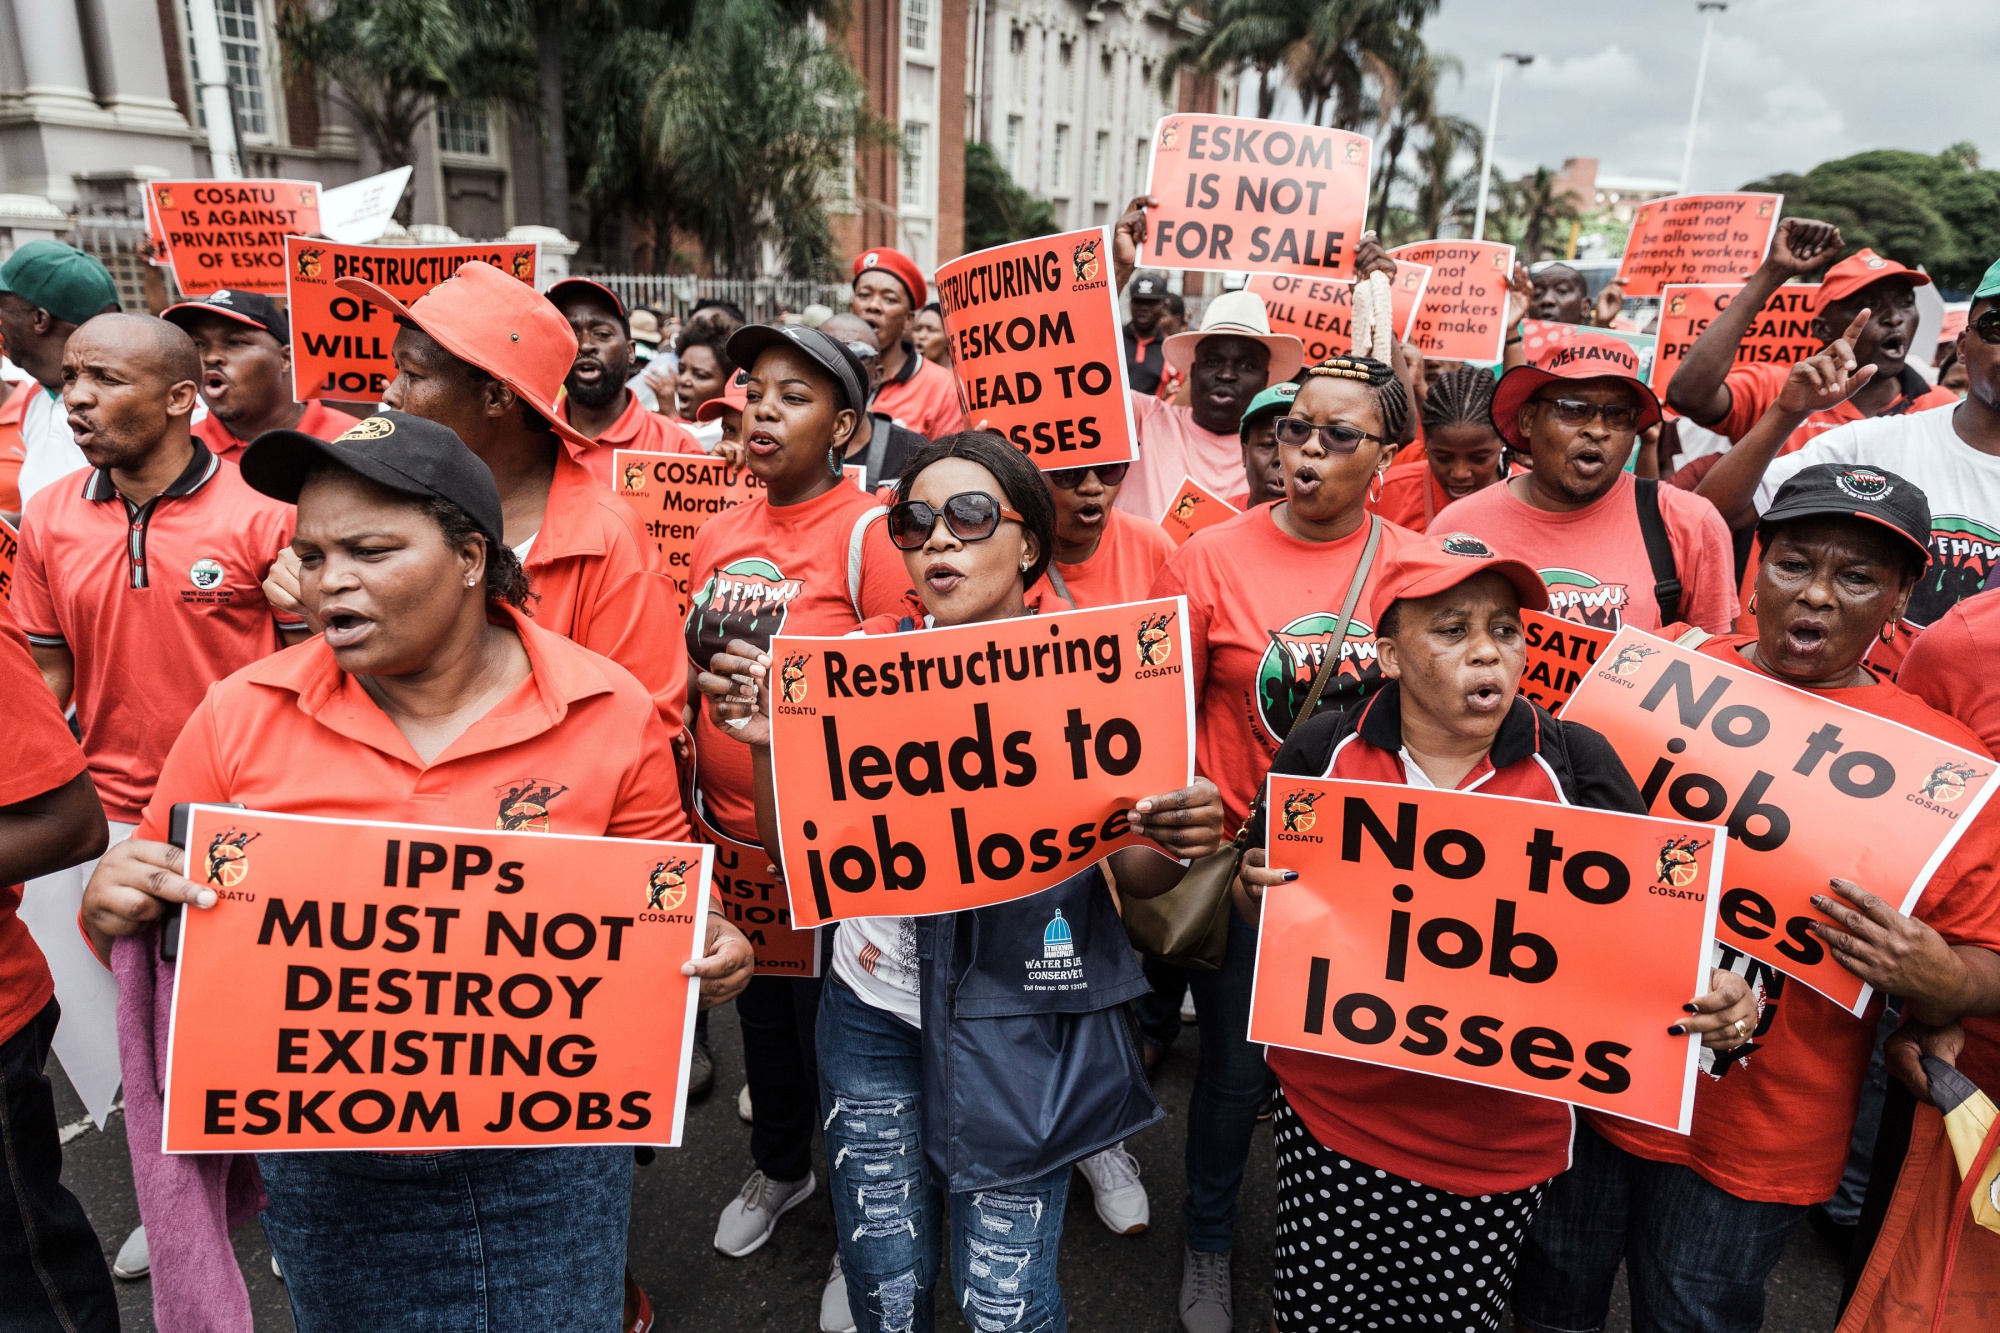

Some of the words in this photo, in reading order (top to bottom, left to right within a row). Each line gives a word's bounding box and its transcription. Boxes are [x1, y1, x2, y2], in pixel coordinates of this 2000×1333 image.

[1188, 125, 1332, 170] ESKOM
[194, 188, 275, 204] COSATU
[1185, 173, 1220, 210] IS
[1235, 175, 1327, 216] NOT
[181, 210, 200, 226] IS
[208, 210, 297, 226] AGAINST
[1659, 203, 1668, 213] A
[1673, 200, 1746, 214] company
[1663, 216, 1700, 227] must
[1705, 215, 1732, 226] not
[170, 231, 304, 247] PRIVATISATI
[1155, 220, 1233, 261] FOR
[1248, 226, 1345, 269] SALE
[1642, 233, 1658, 244] be
[1663, 229, 1727, 243] allowed
[1733, 231, 1749, 242] to
[198, 253, 225, 268] OF
[1406, 249, 1480, 264] company
[1628, 245, 1685, 259] retrench
[1691, 246, 1759, 259] workers
[295, 276, 327, 285] COSATU
[1438, 266, 1466, 277] not
[1629, 261, 1676, 277] simply
[1681, 263, 1696, 273] to
[1701, 261, 1748, 274] make
[1072, 280, 1107, 292] COSATU
[1273, 275, 1303, 294] OF
[1308, 282, 1353, 306] ESK
[1469, 285, 1485, 297] to
[329, 297, 377, 322] OF
[1265, 300, 1296, 324] ILL
[1426, 299, 1498, 316] workers
[1714, 294, 1815, 313] CATU
[960, 310, 1075, 362] ESKOM
[1415, 319, 1431, 330] to
[1438, 318, 1488, 334] make
[302, 331, 388, 359] WILL
[1548, 346, 1633, 371] NEHAWU
[967, 371, 1042, 412] LEAD
[1054, 361, 1112, 399] TO
[654, 462, 738, 487] COSATU
[1169, 512, 1190, 529] COSATU
[1928, 537, 2000, 560] EHAW
[1549, 586, 1622, 610] HAWU
[1522, 622, 1611, 666] SATU
[823, 624, 1121, 698] Restructuring
[1134, 664, 1182, 680] COSATU
[1598, 670, 1635, 689] COSATU
[778, 705, 817, 716] COSATU
[1247, 709, 1269, 748] INJURY
[1639, 658, 1771, 748] No
[1792, 722, 1896, 799] to
[822, 702, 1037, 801] leads
[1064, 708, 1142, 780] to
[1640, 737, 1791, 853] job
[1906, 793, 1959, 820] COSATU
[1277, 833, 1324, 844] COSATU
[1342, 796, 1486, 880] No
[1526, 828, 1631, 905] to
[384, 839, 525, 895] IPPs
[803, 814, 926, 920] job
[213, 888, 256, 902] SATU
[1648, 885, 1705, 902] COSATU
[257, 898, 460, 953] MUST
[484, 911, 634, 961] NOT
[639, 913, 693, 924] COSATU
[1719, 887, 1825, 967] es
[1385, 884, 1558, 984] job
[754, 957, 807, 971] kom)
[1025, 959, 1061, 969] WATER
[1063, 959, 1072, 968] IS
[1028, 969, 1078, 980] CONSERVE
[284, 965, 603, 1019] DESTROY
[1304, 956, 1633, 1094] losses
[276, 1028, 599, 1078] EXISTING
[204, 1089, 460, 1136] ESKOM
[484, 1090, 653, 1133] JOBS
